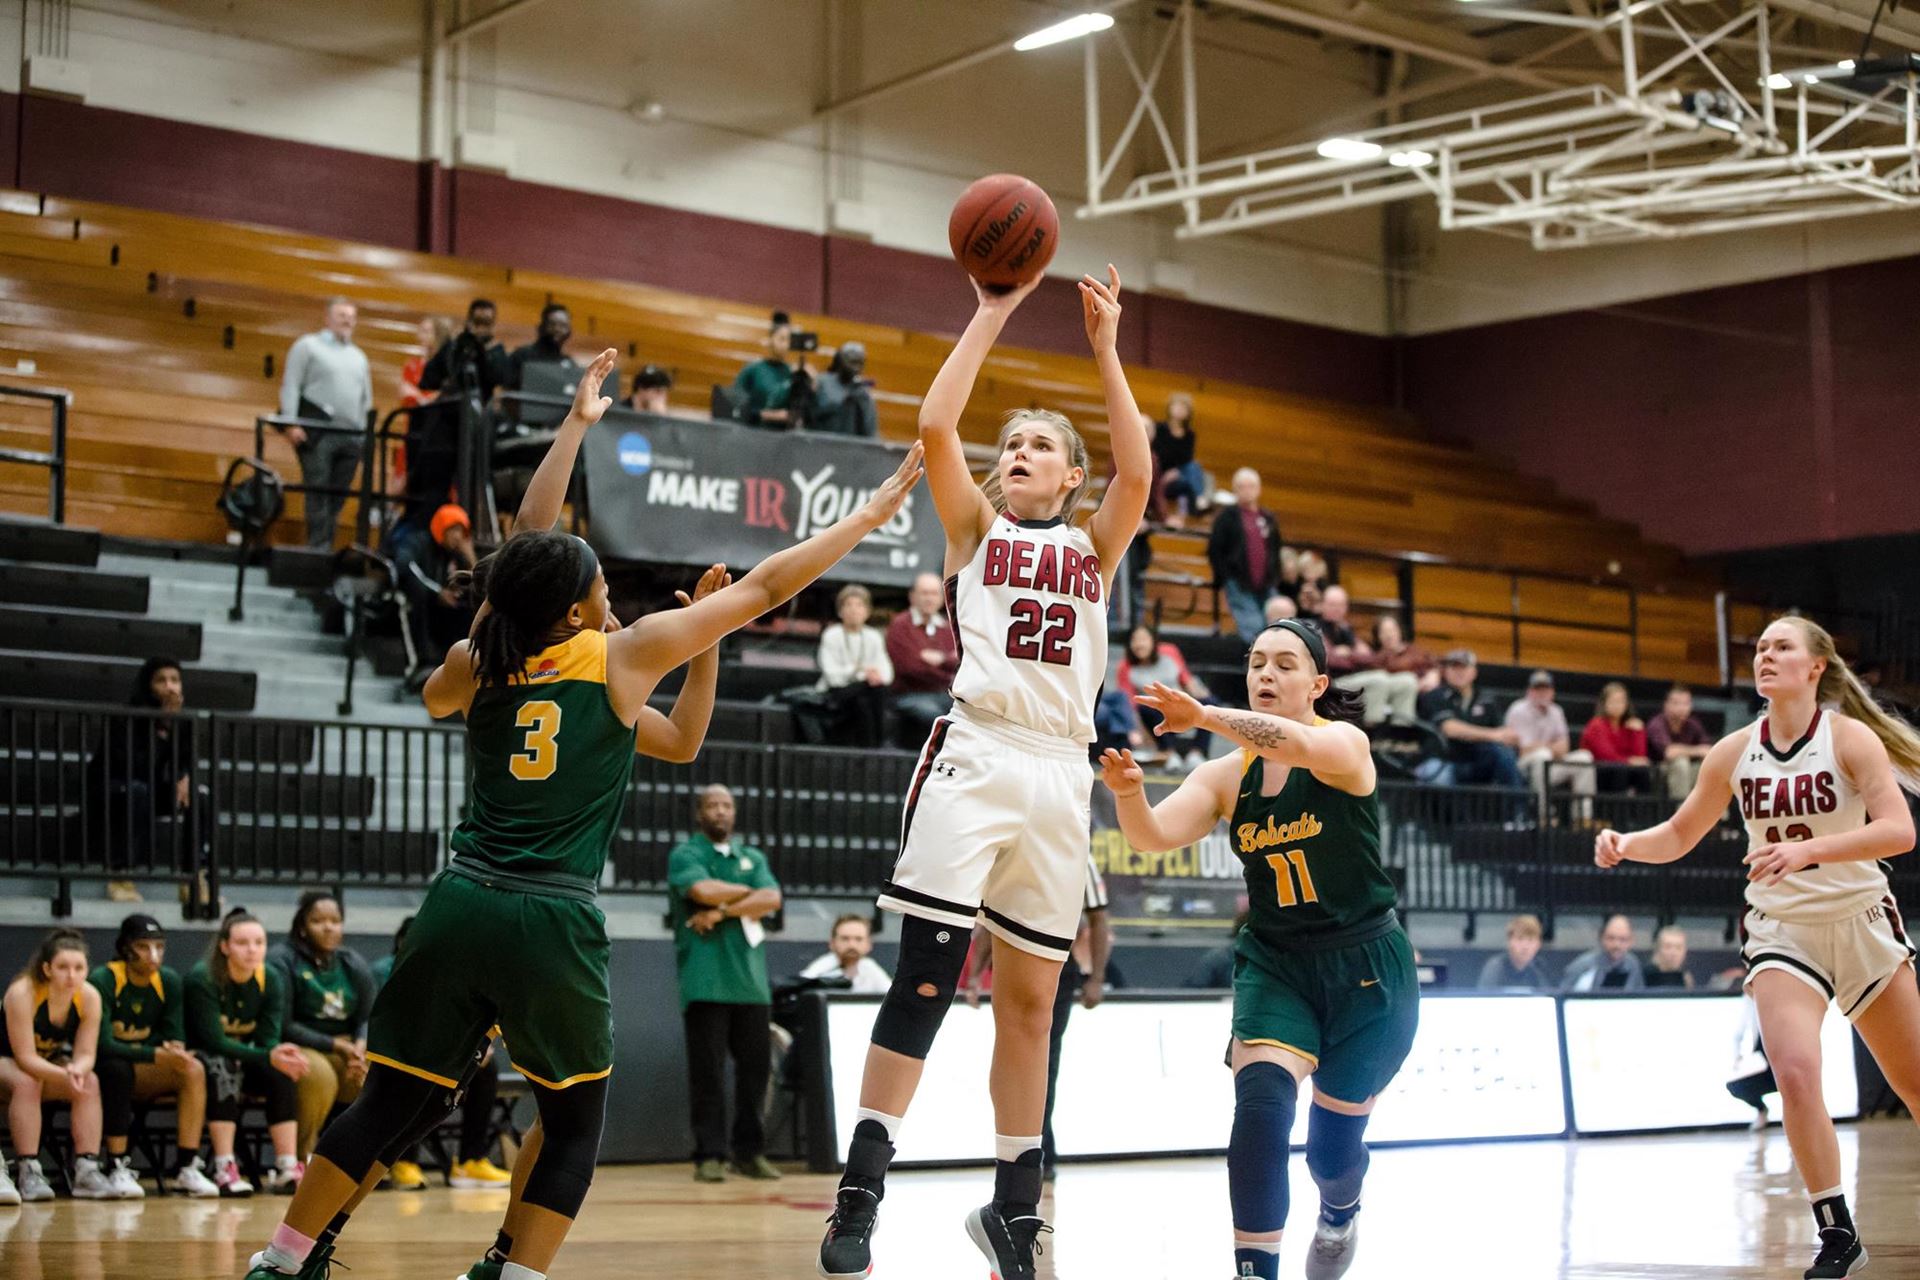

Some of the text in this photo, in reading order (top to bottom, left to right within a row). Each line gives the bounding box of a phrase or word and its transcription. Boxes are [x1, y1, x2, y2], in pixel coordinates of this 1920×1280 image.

[973, 201, 1028, 258] Wilson
[647, 470, 741, 513] MAKE
[790, 463, 914, 540] YOUS
[983, 538, 1101, 604] BEARS
[1005, 598, 1077, 666] 22
[508, 700, 562, 780] 3
[1740, 771, 1837, 819] BEARS
[1236, 811, 1322, 853] Bobcats
[1265, 849, 1319, 908] 11
